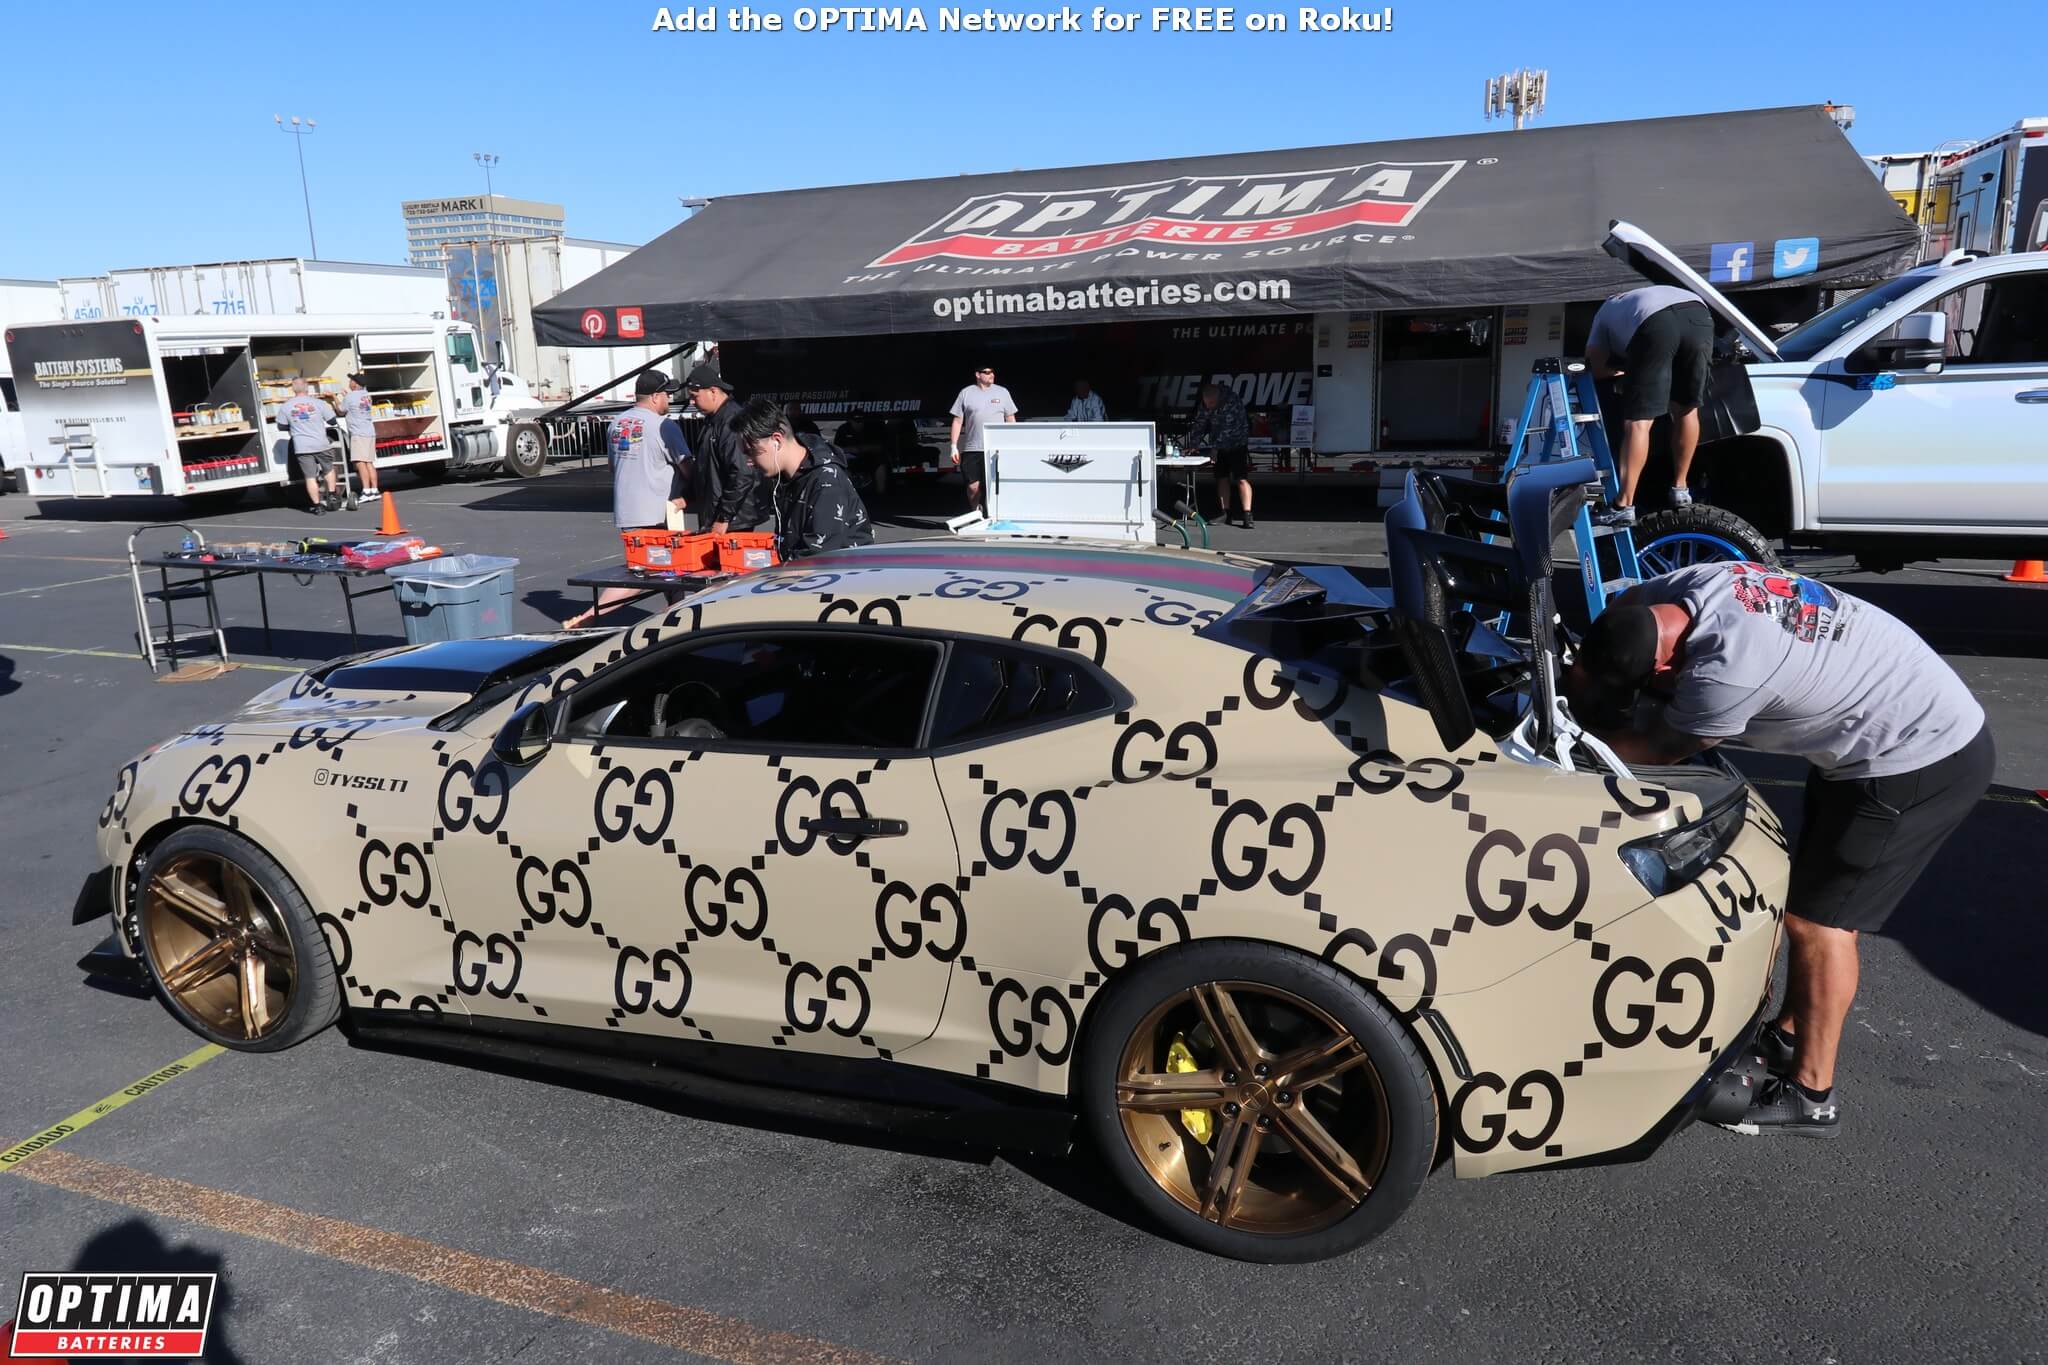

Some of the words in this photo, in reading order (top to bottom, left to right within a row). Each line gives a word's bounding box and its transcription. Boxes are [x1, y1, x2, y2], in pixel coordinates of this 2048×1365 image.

[441, 198, 477, 212] MARK
[944, 169, 1413, 232] OPTIMA
[992, 221, 1297, 255] BATTERIES
[842, 270, 900, 283] THE
[913, 260, 1077, 276] ULTIMATE
[1090, 246, 1223, 263] POWER
[213, 301, 246, 315] 7715
[933, 279, 1291, 321] optimabatteries.com
[1172, 327, 1201, 339] THE
[1209, 323, 1287, 337] ULTIMATE
[34, 360, 75, 376] BATTERY
[76, 358, 123, 374] SYSTEMS
[39, 381, 50, 389] The
[52, 380, 71, 389] Single
[72, 379, 95, 387] Source
[779, 391, 800, 400] YOUR
[802, 390, 837, 400] PASSION
[1818, 612, 1832, 640] 2017
[124, 1064, 188, 1097] CAUTION
[0, 1124, 75, 1164] CUIDADO
